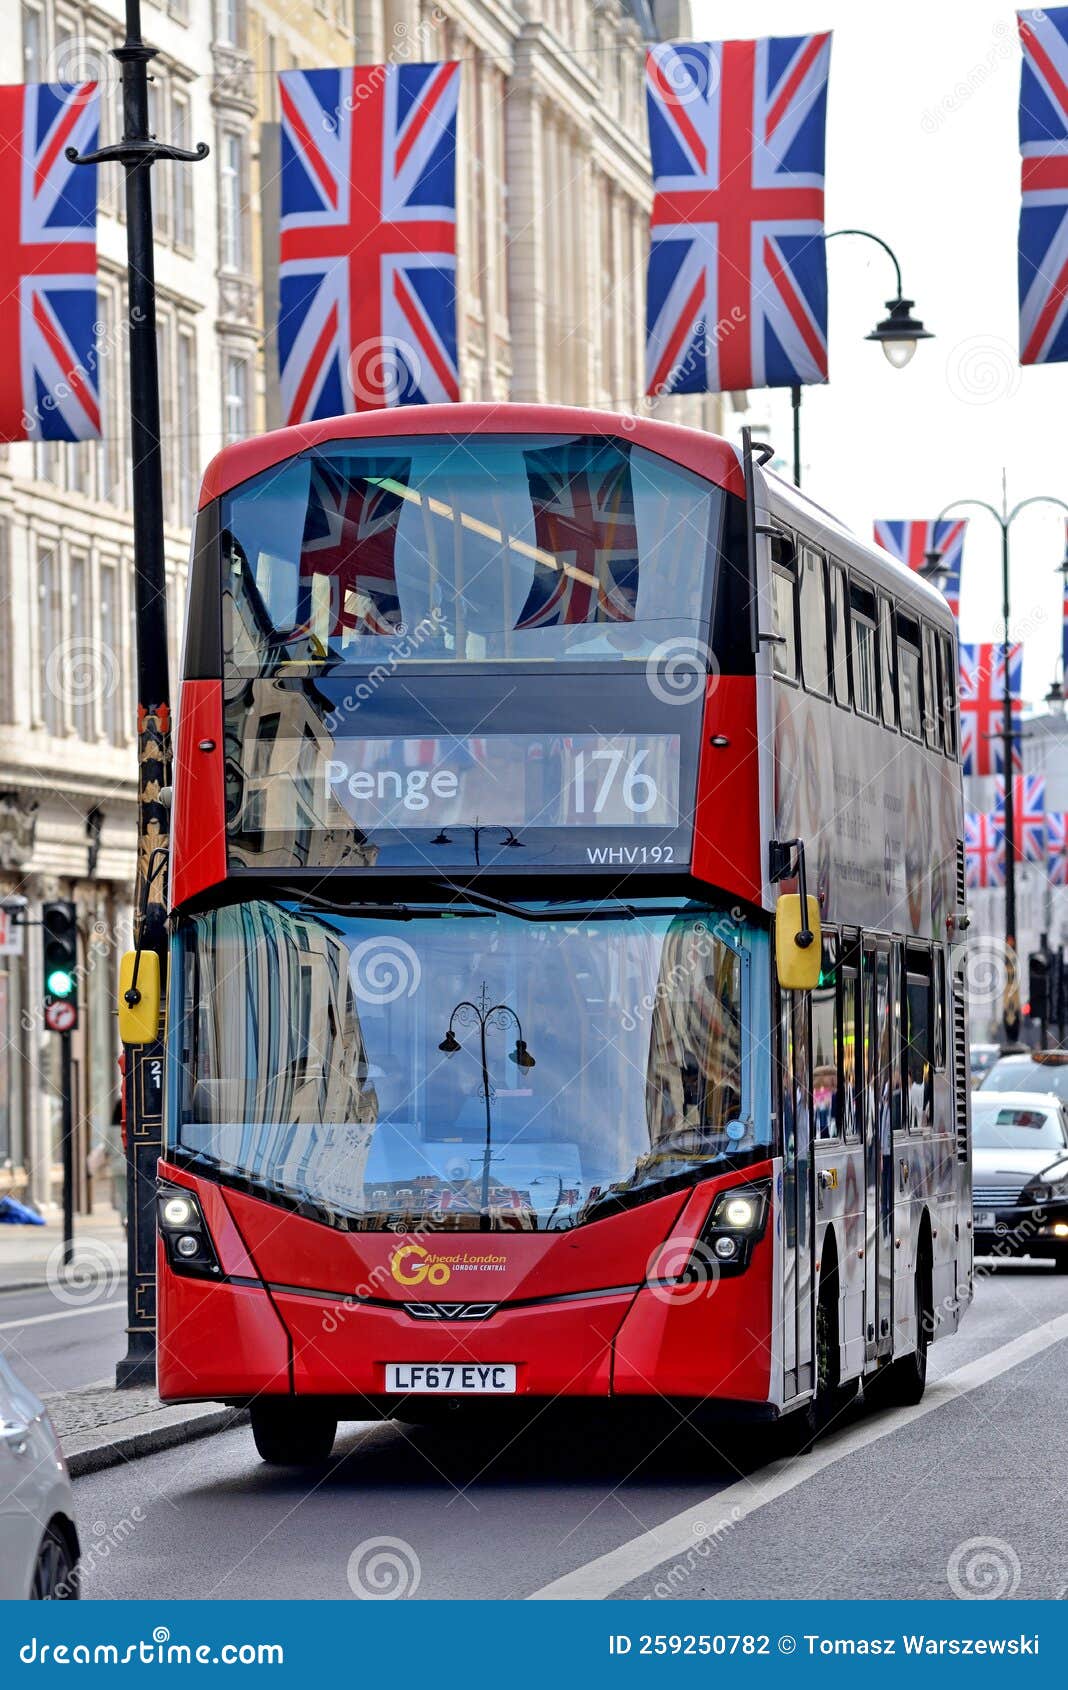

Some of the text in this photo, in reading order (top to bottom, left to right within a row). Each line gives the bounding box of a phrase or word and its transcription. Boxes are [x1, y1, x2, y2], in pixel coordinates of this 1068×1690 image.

[324, 749, 657, 813] Penge 176
[587, 846, 675, 865] WHV192
[391, 1245, 451, 1286] Go
[424, 1253, 507, 1264] Ahead-London
[452, 1264, 507, 1272] LONDON CENTRAL
[395, 1367, 506, 1388] LF67 EYC
